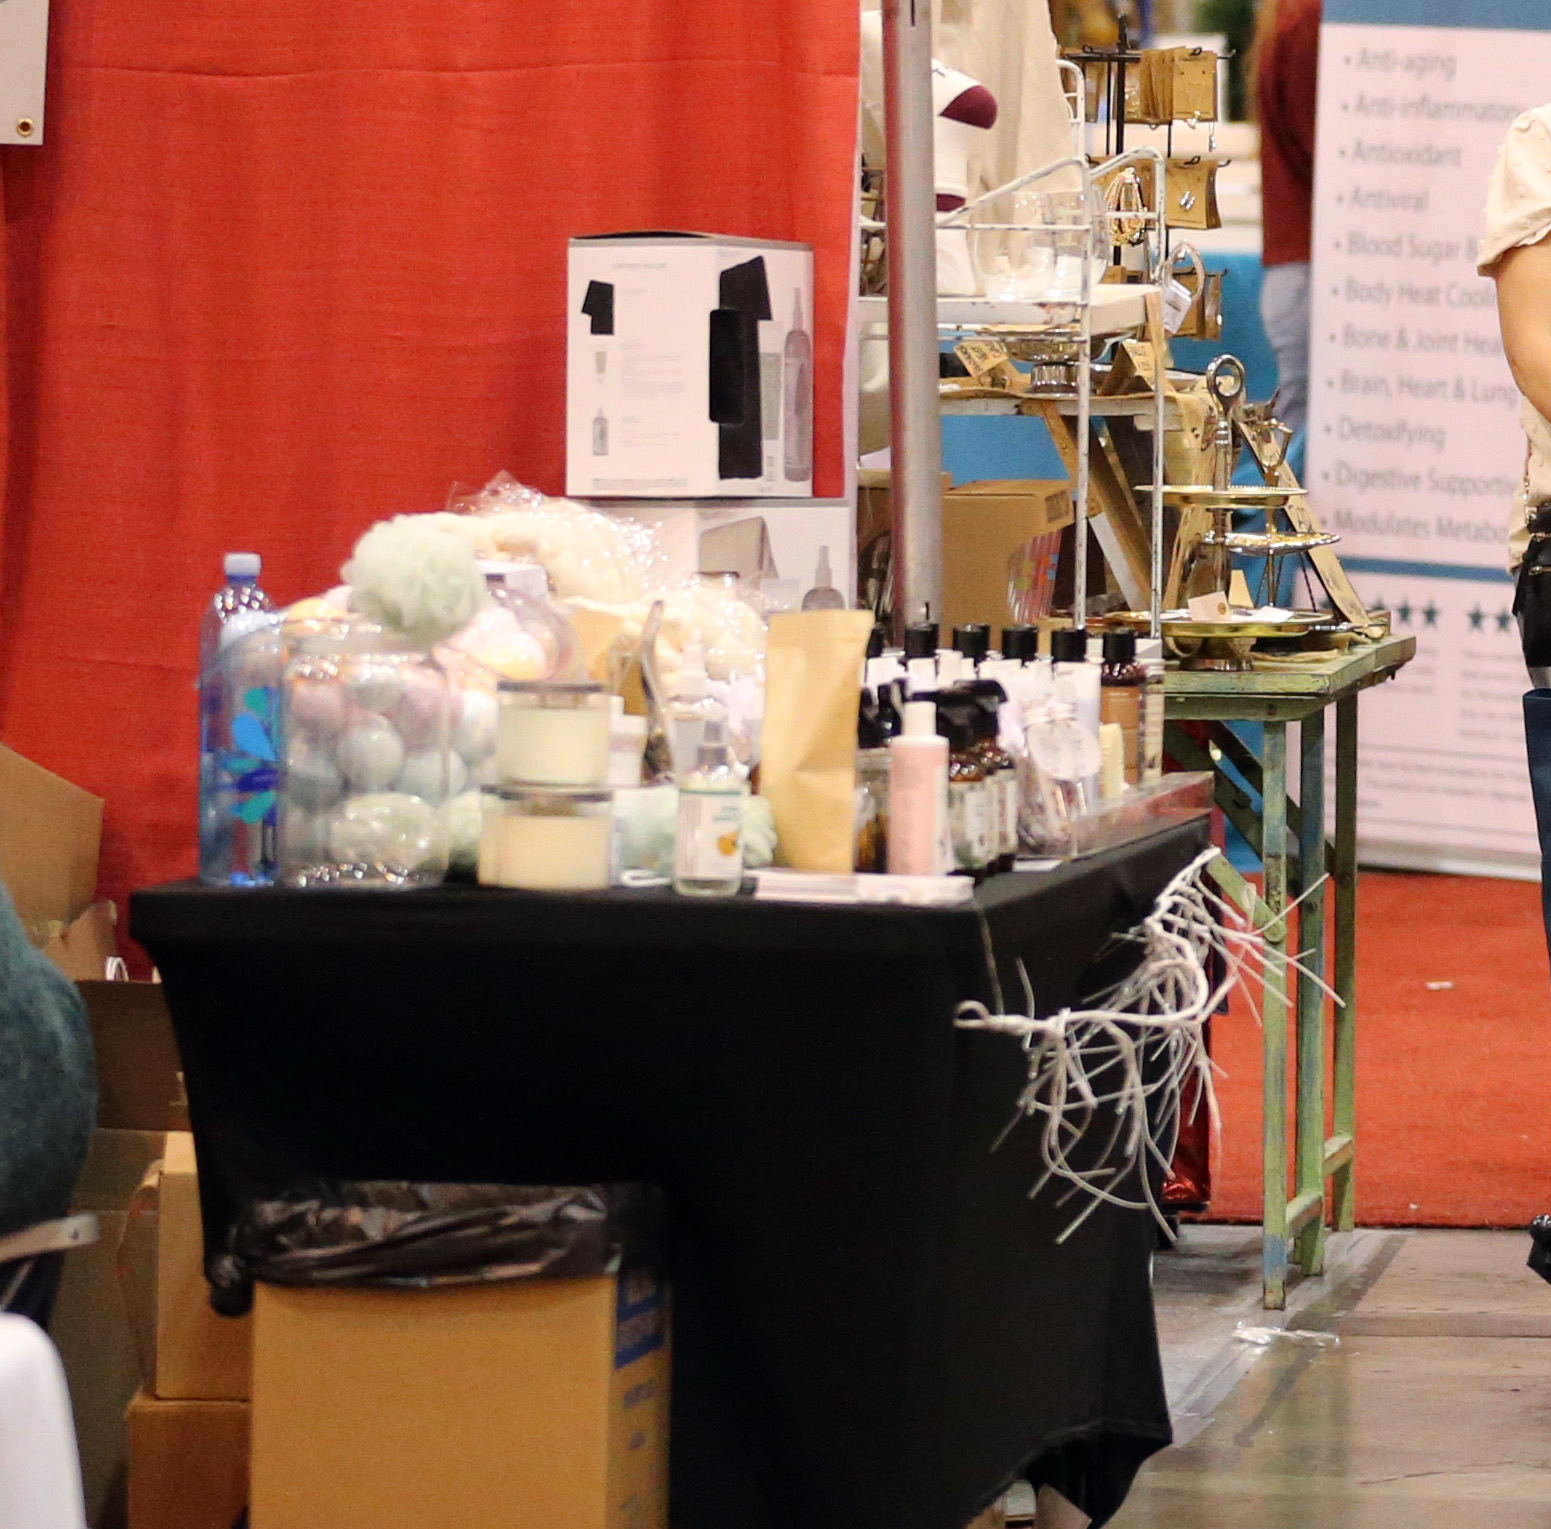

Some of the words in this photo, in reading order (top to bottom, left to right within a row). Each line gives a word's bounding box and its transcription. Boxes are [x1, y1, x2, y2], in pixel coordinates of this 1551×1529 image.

[1356, 48, 1458, 81] Anti-aging
[1351, 141, 1463, 168] Antioxidant
[1349, 187, 1430, 213] Antiviral
[1346, 230, 1402, 257] Blood
[1405, 234, 1461, 265] Sugar
[1344, 276, 1391, 308] Body
[1397, 281, 1441, 307] Heat
[1343, 323, 1391, 349] Bone
[1412, 329, 1458, 353] Joint
[1464, 330, 1504, 356] Hea
[1397, 374, 1448, 399] Heart
[1338, 414, 1447, 453] Detoxifying
[1335, 460, 1423, 494] Digestive
[1428, 467, 1518, 499] Supporti
[1435, 514, 1508, 544] Metabo
